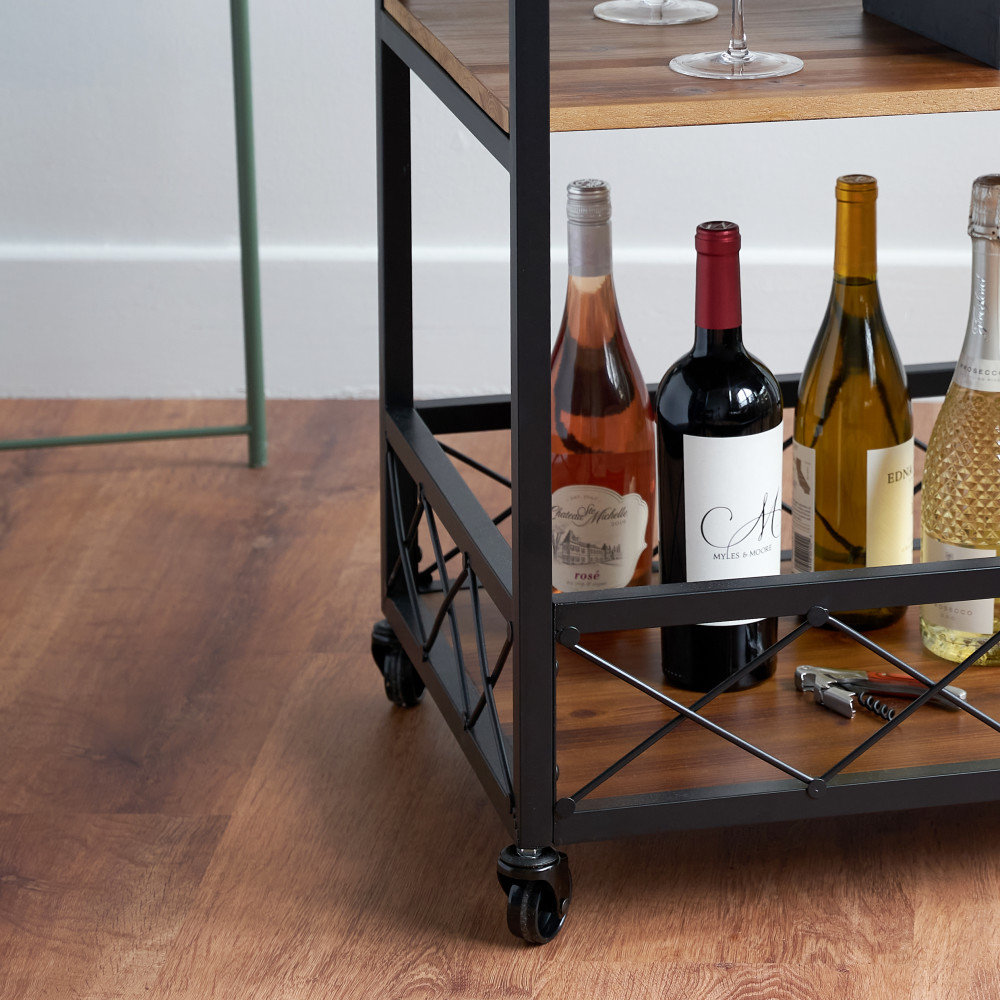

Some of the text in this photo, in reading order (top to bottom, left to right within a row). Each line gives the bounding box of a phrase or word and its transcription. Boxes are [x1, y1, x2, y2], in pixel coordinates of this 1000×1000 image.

[713, 552, 740, 560] MYLES
[749, 545, 772, 557] MOORE
[574, 569, 600, 580] rosé
